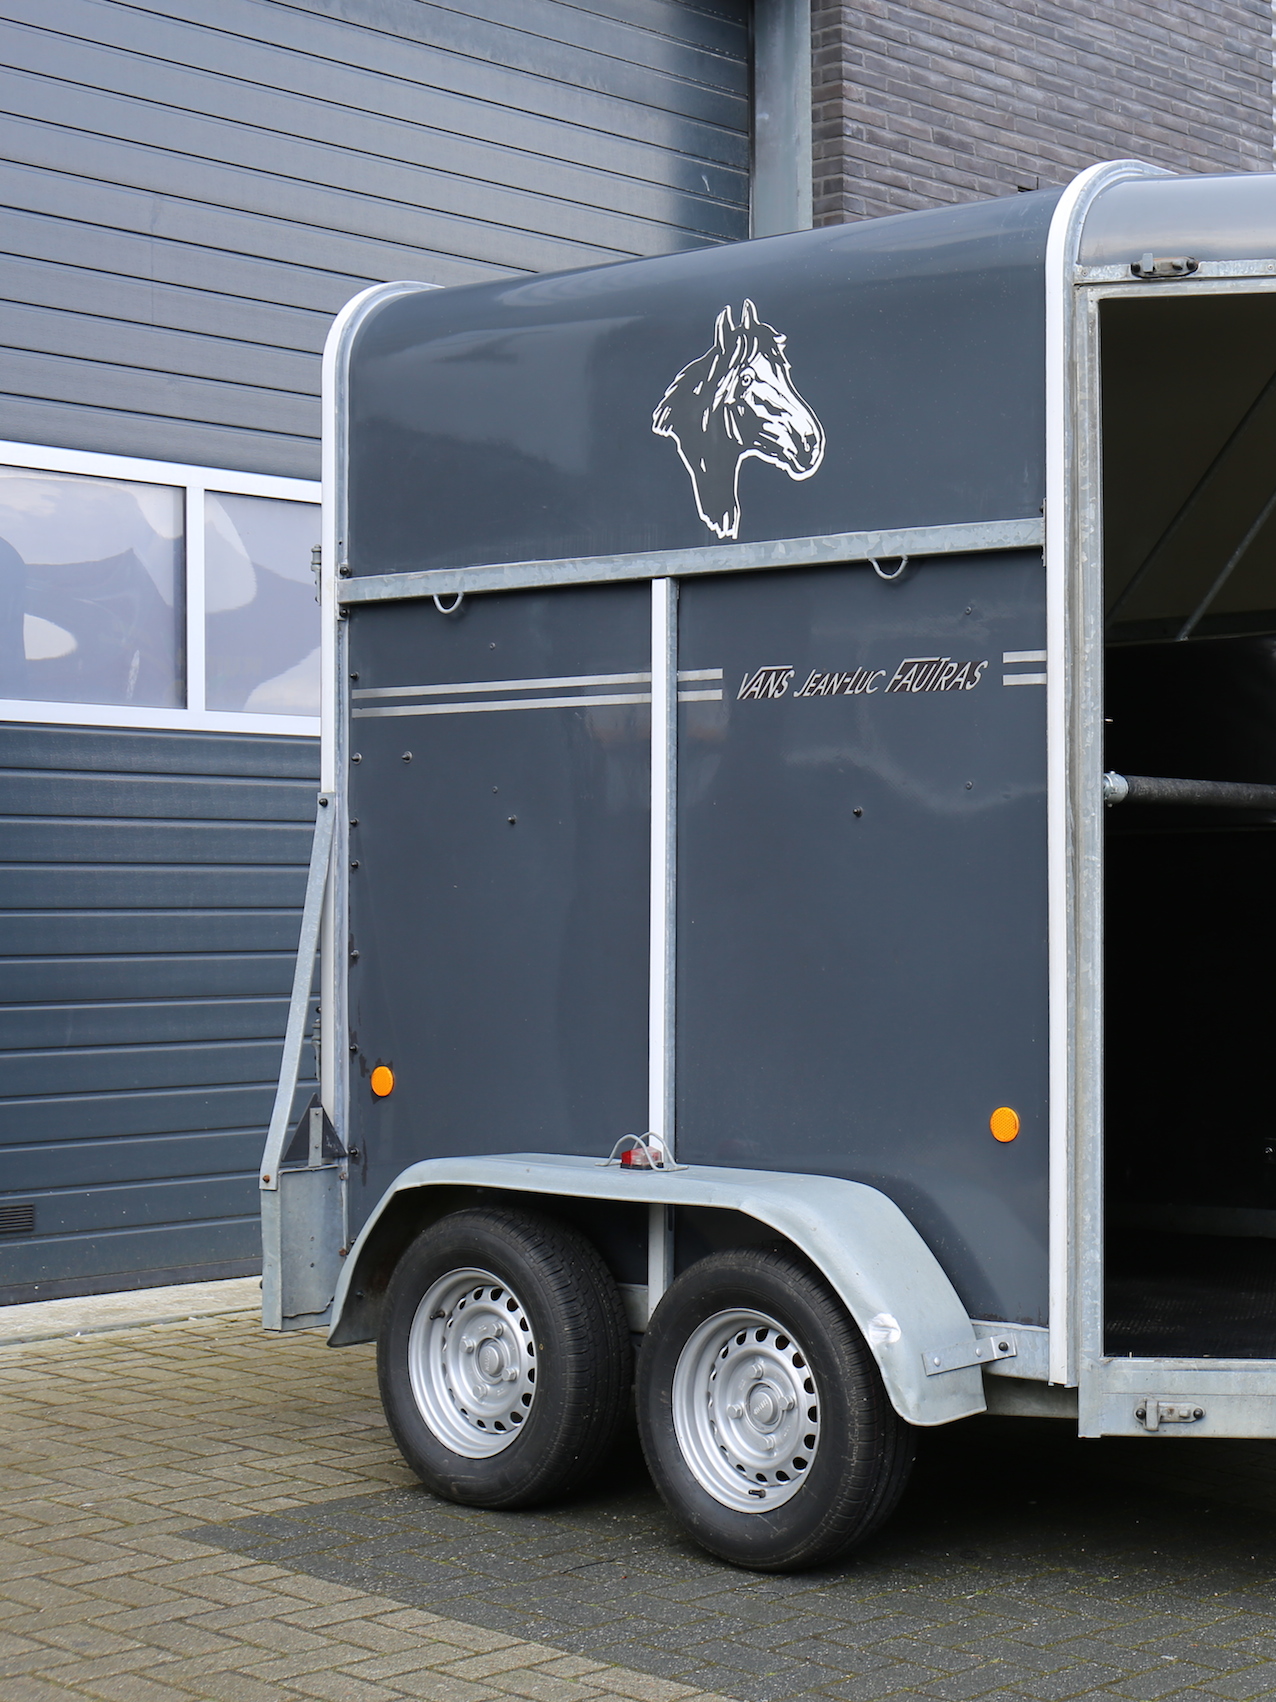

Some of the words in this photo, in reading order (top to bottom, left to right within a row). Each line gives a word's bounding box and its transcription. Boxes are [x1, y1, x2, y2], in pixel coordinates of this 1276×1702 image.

[736, 665, 795, 700] VANS
[793, 666, 887, 698] JEAN-LUC
[884, 657, 989, 693] FAUTRAS
